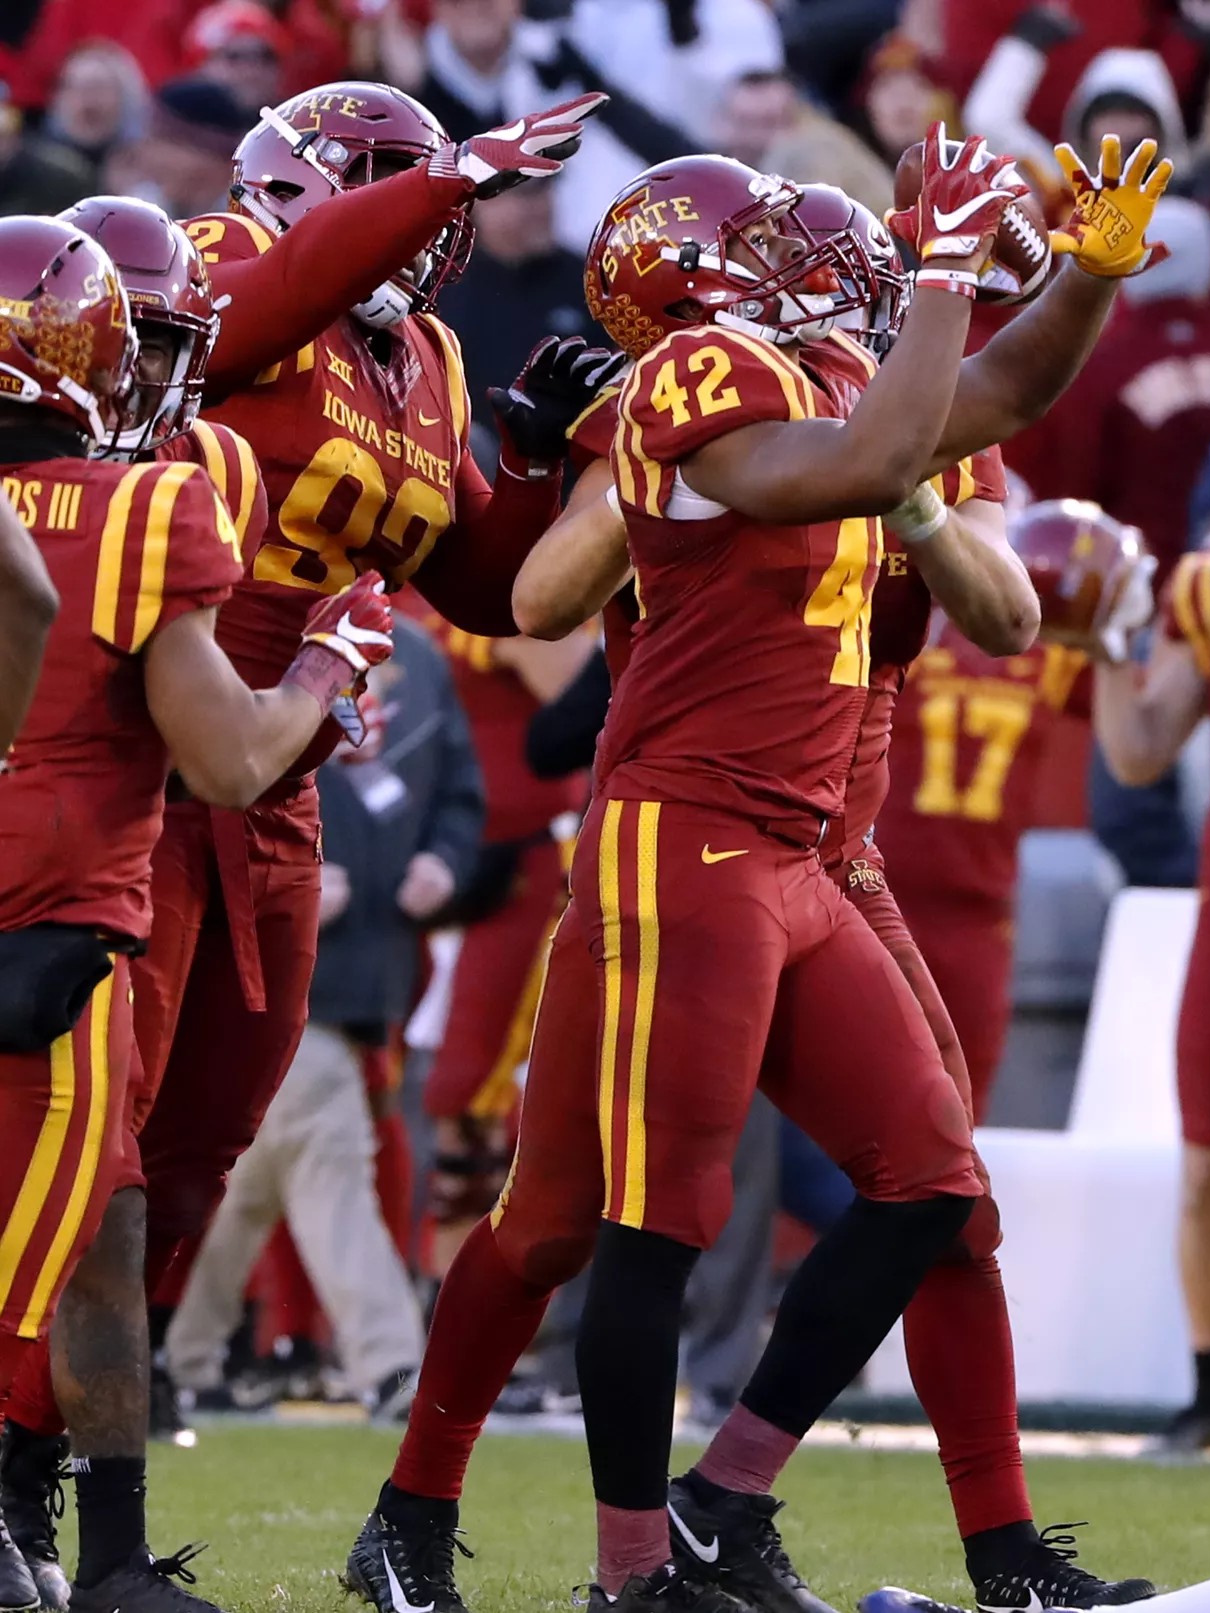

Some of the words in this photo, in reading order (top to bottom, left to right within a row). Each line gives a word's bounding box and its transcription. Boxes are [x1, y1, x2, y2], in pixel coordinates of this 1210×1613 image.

[186, 220, 226, 264] 2
[602, 196, 699, 283] STATE
[1075, 191, 1134, 251] ATE
[325, 346, 355, 391] XII
[650, 345, 742, 428] 42
[322, 389, 382, 450] IOWA
[384, 428, 451, 489] STATE
[46, 482, 83, 530] III
[213, 491, 243, 563] 4
[804, 515, 884, 688] 4
[914, 693, 1031, 822] 17
